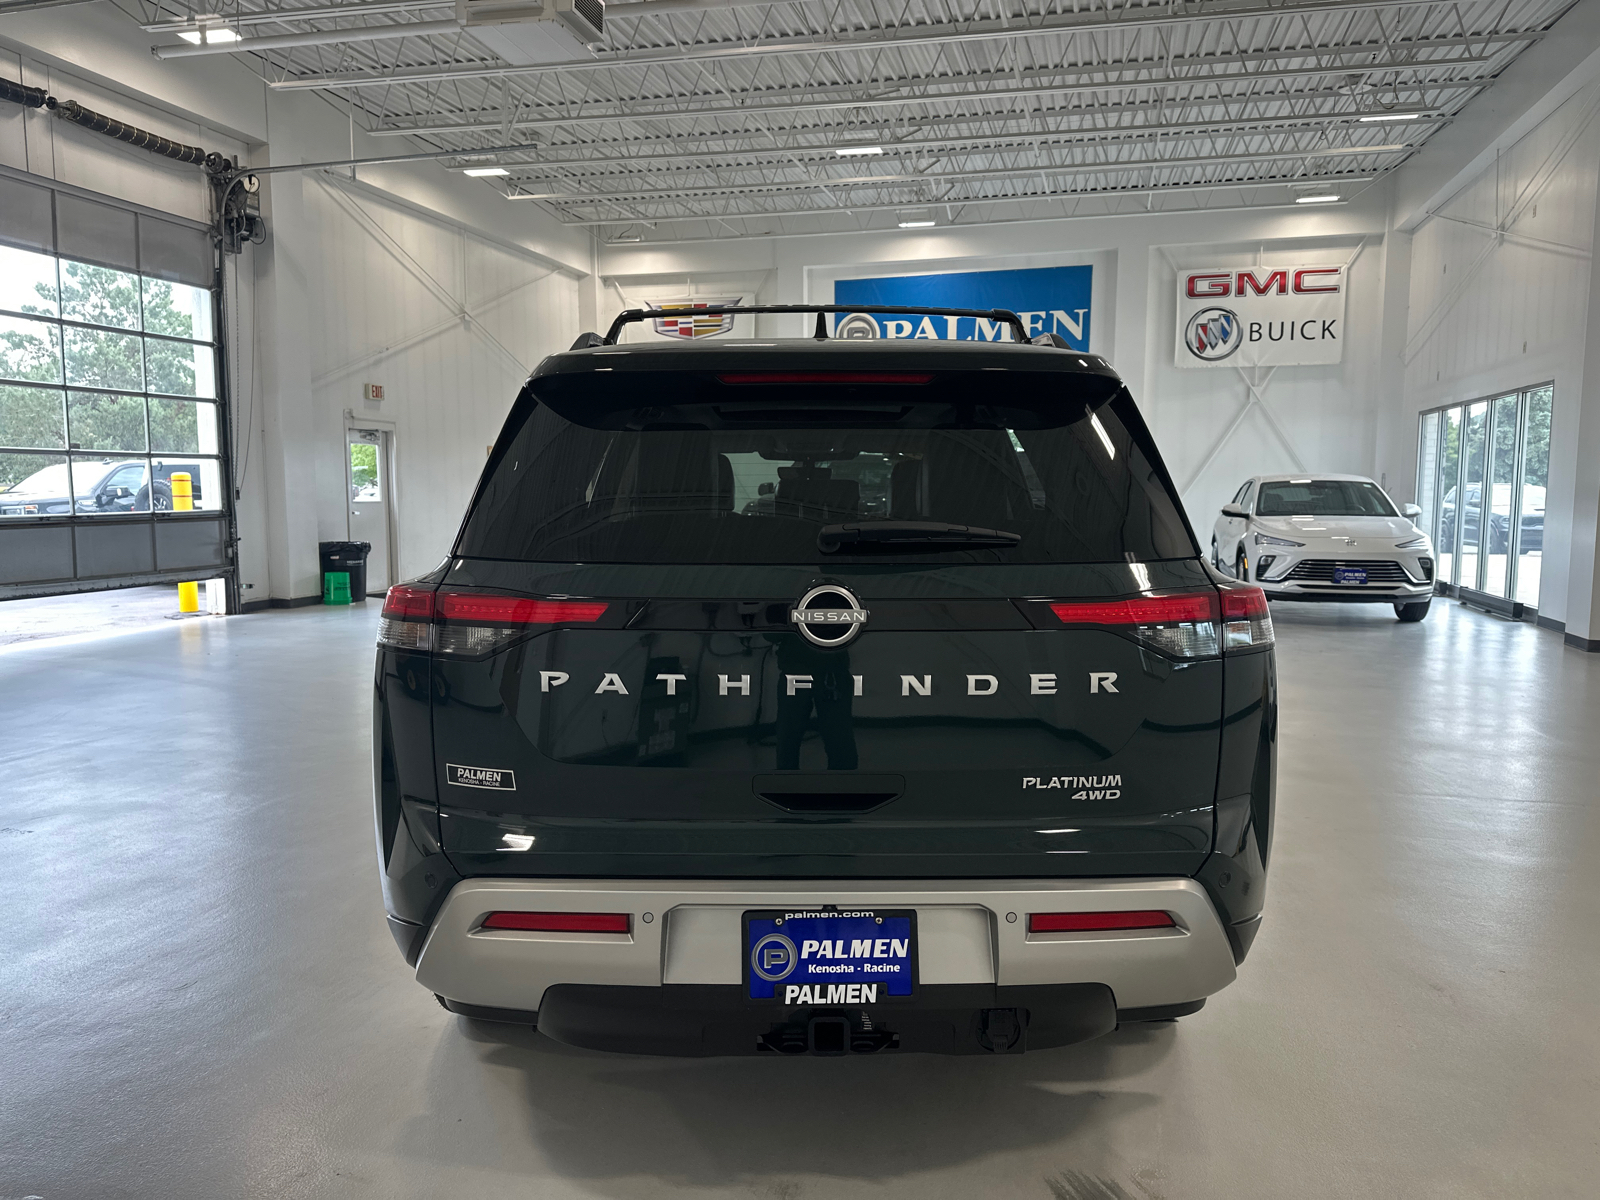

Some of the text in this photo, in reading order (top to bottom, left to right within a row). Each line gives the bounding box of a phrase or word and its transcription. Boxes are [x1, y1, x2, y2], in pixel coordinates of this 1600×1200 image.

[1186, 267, 1341, 299] GMC
[883, 309, 1088, 342] PALMEN
[1249, 319, 1337, 342] BUICK
[372, 385, 382, 398] EXIT
[793, 611, 866, 622] NISSAN
[538, 670, 1120, 697] PATHFINDER
[457, 768, 501, 781] PALMEN
[1022, 774, 1122, 789] PLATINUM
[1071, 789, 1121, 801] 4WD
[784, 910, 875, 921] palmen.com
[800, 938, 909, 960] PALMEN
[808, 963, 855, 974] Kenosha
[863, 962, 901, 974] Racine
[785, 984, 877, 1005] PALMEN
